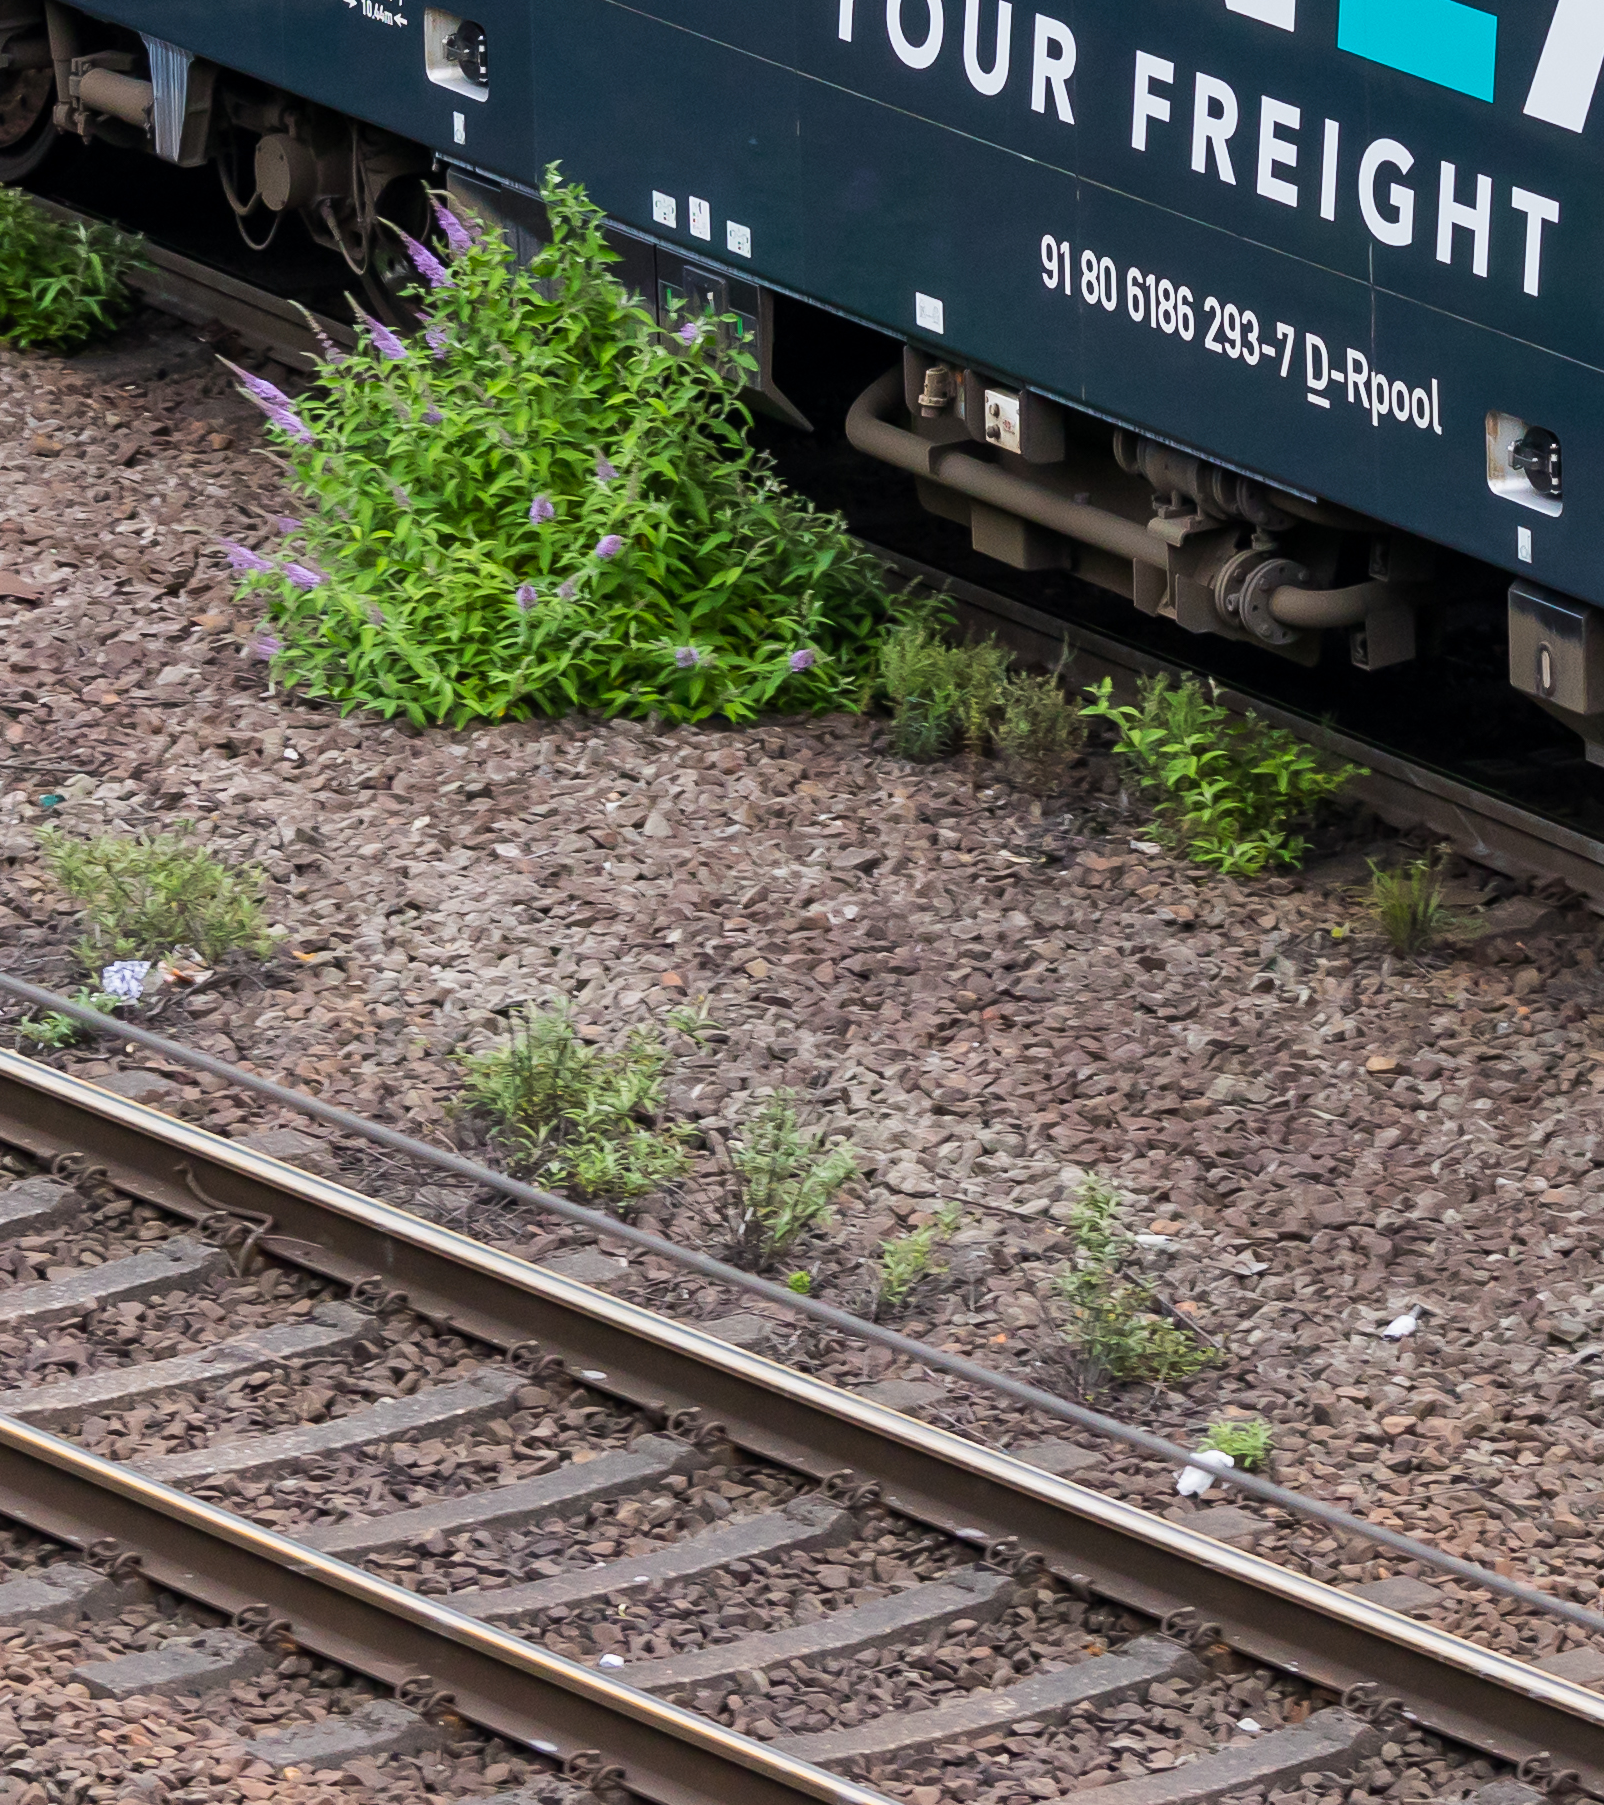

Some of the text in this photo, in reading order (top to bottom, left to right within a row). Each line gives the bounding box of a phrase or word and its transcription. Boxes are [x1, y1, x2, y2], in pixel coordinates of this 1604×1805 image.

[1131, 49, 1560, 297] FREIGHT
[1040, 234, 1443, 435] 91 80 6186 293-7 D-Rpool
